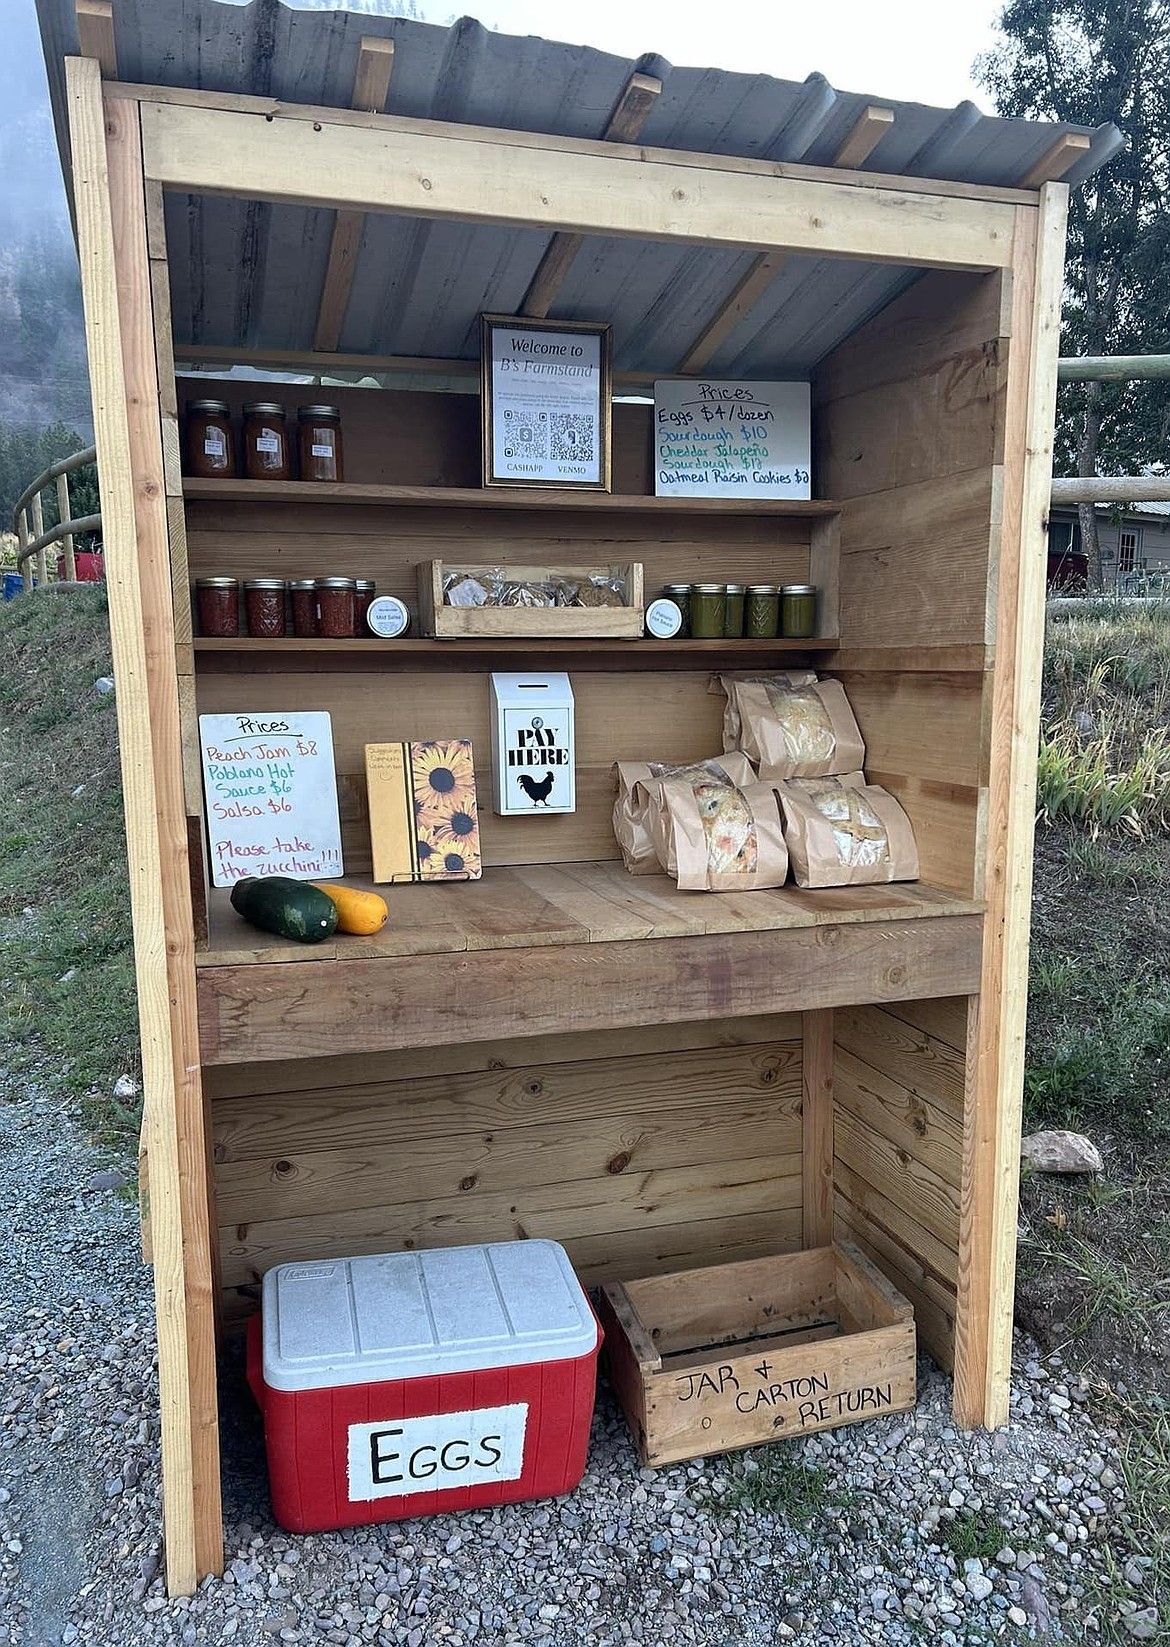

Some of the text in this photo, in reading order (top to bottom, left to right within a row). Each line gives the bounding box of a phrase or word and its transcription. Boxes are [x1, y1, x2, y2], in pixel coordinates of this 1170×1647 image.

[511, 338, 583, 357] Welcome to
[500, 357, 593, 378] B's Farmstand
[698, 383, 754, 400] Prices
[658, 408, 693, 426] Eggs
[658, 425, 768, 446] Sourdough $10
[660, 443, 769, 459] Cheddar Jalapeño
[506, 463, 587, 475] CASHAPP VENMO
[663, 458, 734, 473] Sourdough
[659, 469, 809, 484] Oatmeal Raisin Cookies $2
[236, 716, 290, 734] Prices
[517, 728, 559, 747] PAY
[206, 739, 318, 762] Peach Jam $8
[508, 748, 569, 766] HERE
[208, 762, 295, 781] Poblano Hot
[215, 780, 292, 799] Sauce $6
[213, 797, 292, 820] Salsa $6
[216, 836, 315, 860] Please take
[218, 862, 252, 879] the
[675, 1365, 740, 1401] JAR
[735, 1372, 829, 1413] CARTON
[798, 1383, 892, 1427] RETURN
